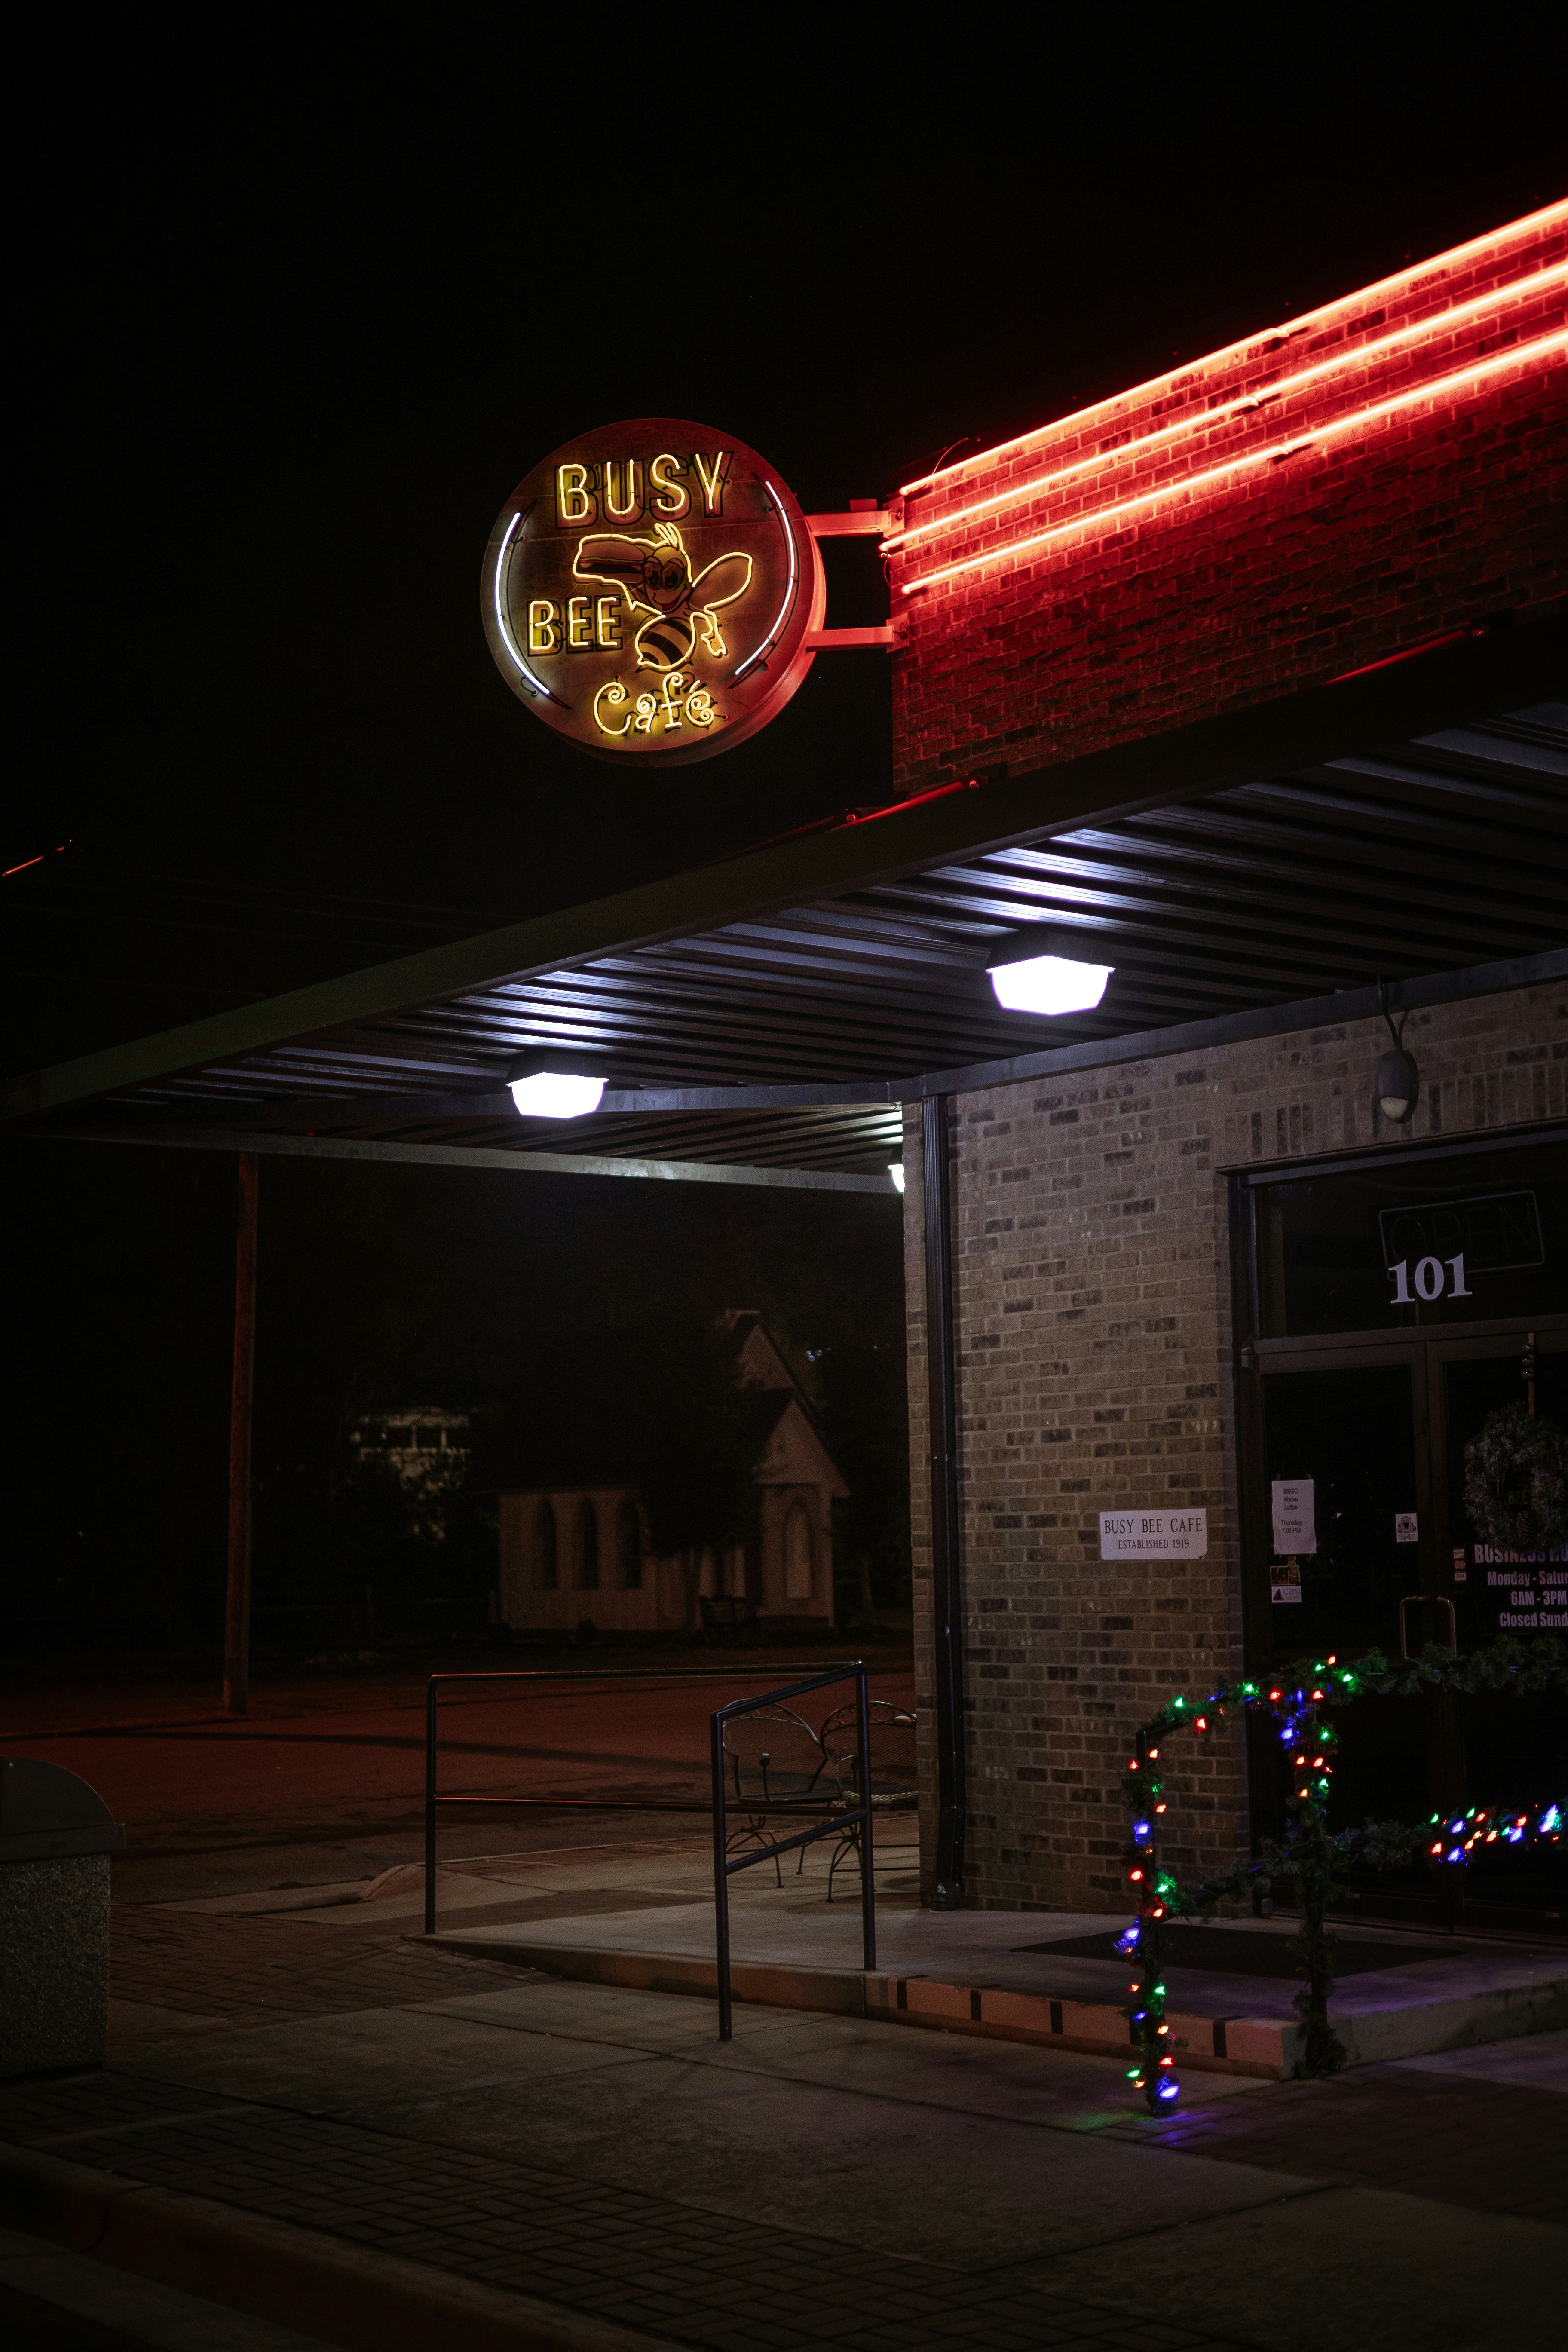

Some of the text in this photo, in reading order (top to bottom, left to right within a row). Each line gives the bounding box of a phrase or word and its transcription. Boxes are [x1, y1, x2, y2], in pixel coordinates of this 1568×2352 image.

[556, 451, 732, 528] BUSY
[527, 595, 623, 656] BEE
[593, 671, 715, 736] Café
[1388, 1253, 1473, 1304] 101
[1104, 1518, 1203, 1534] BUSY BEE CAFE
[1118, 1539, 1189, 1549] ESTABLISHED 1919
[1487, 1571, 1530, 1586] Monday
[1510, 1591, 1535, 1605] 6AM
[1543, 1590, 1568, 1605] 3PM
[1500, 1611, 1568, 1627] Closed Sund
